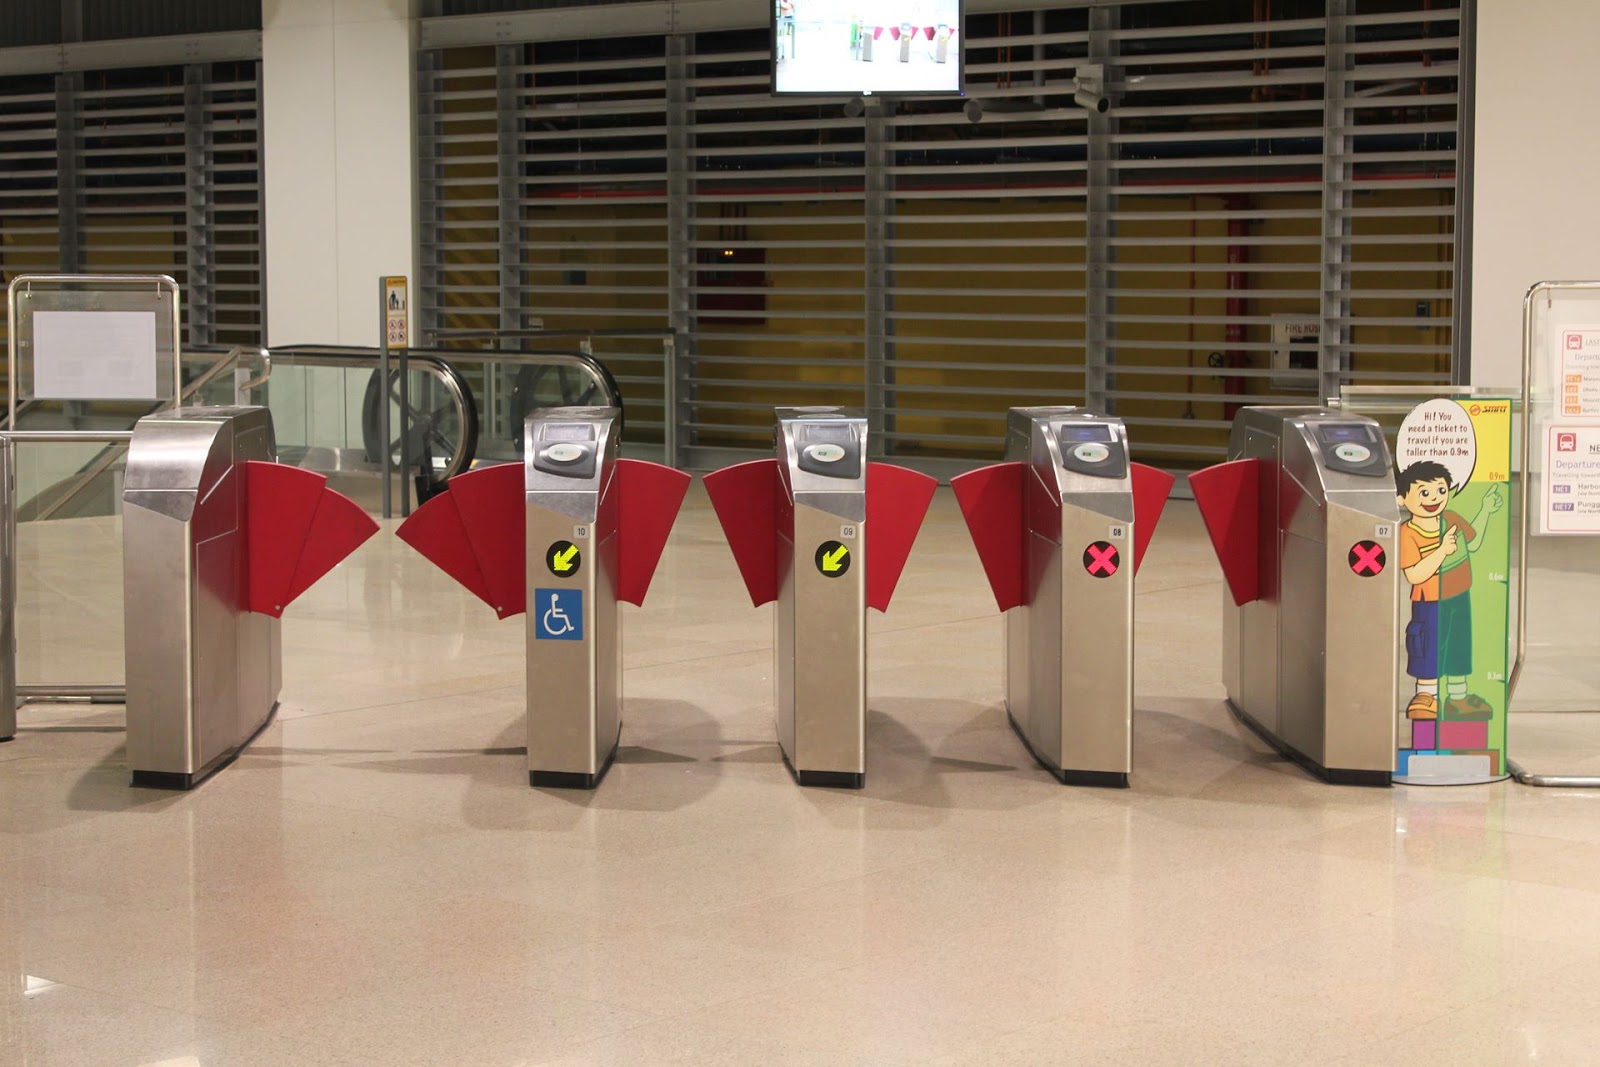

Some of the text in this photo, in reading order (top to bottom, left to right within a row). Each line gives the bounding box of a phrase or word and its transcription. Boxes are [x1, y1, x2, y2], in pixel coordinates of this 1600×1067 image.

[1285, 323, 1302, 333] FIRE
[1482, 405, 1508, 413] SMRT
[1439, 412, 1452, 421] You
[1408, 424, 1426, 433] need
[1434, 424, 1457, 433] ticket
[1460, 425, 1468, 433] to
[1407, 435, 1468, 447] travel if you are
[1406, 448, 1469, 457] taller than 0.9m
[1555, 460, 1600, 469] Departure
[1489, 472, 1505, 480] 0.9m
[578, 527, 586, 536] 10
[843, 527, 853, 536] 09
[1113, 528, 1121, 537] 08
[1379, 527, 1388, 536] 07
